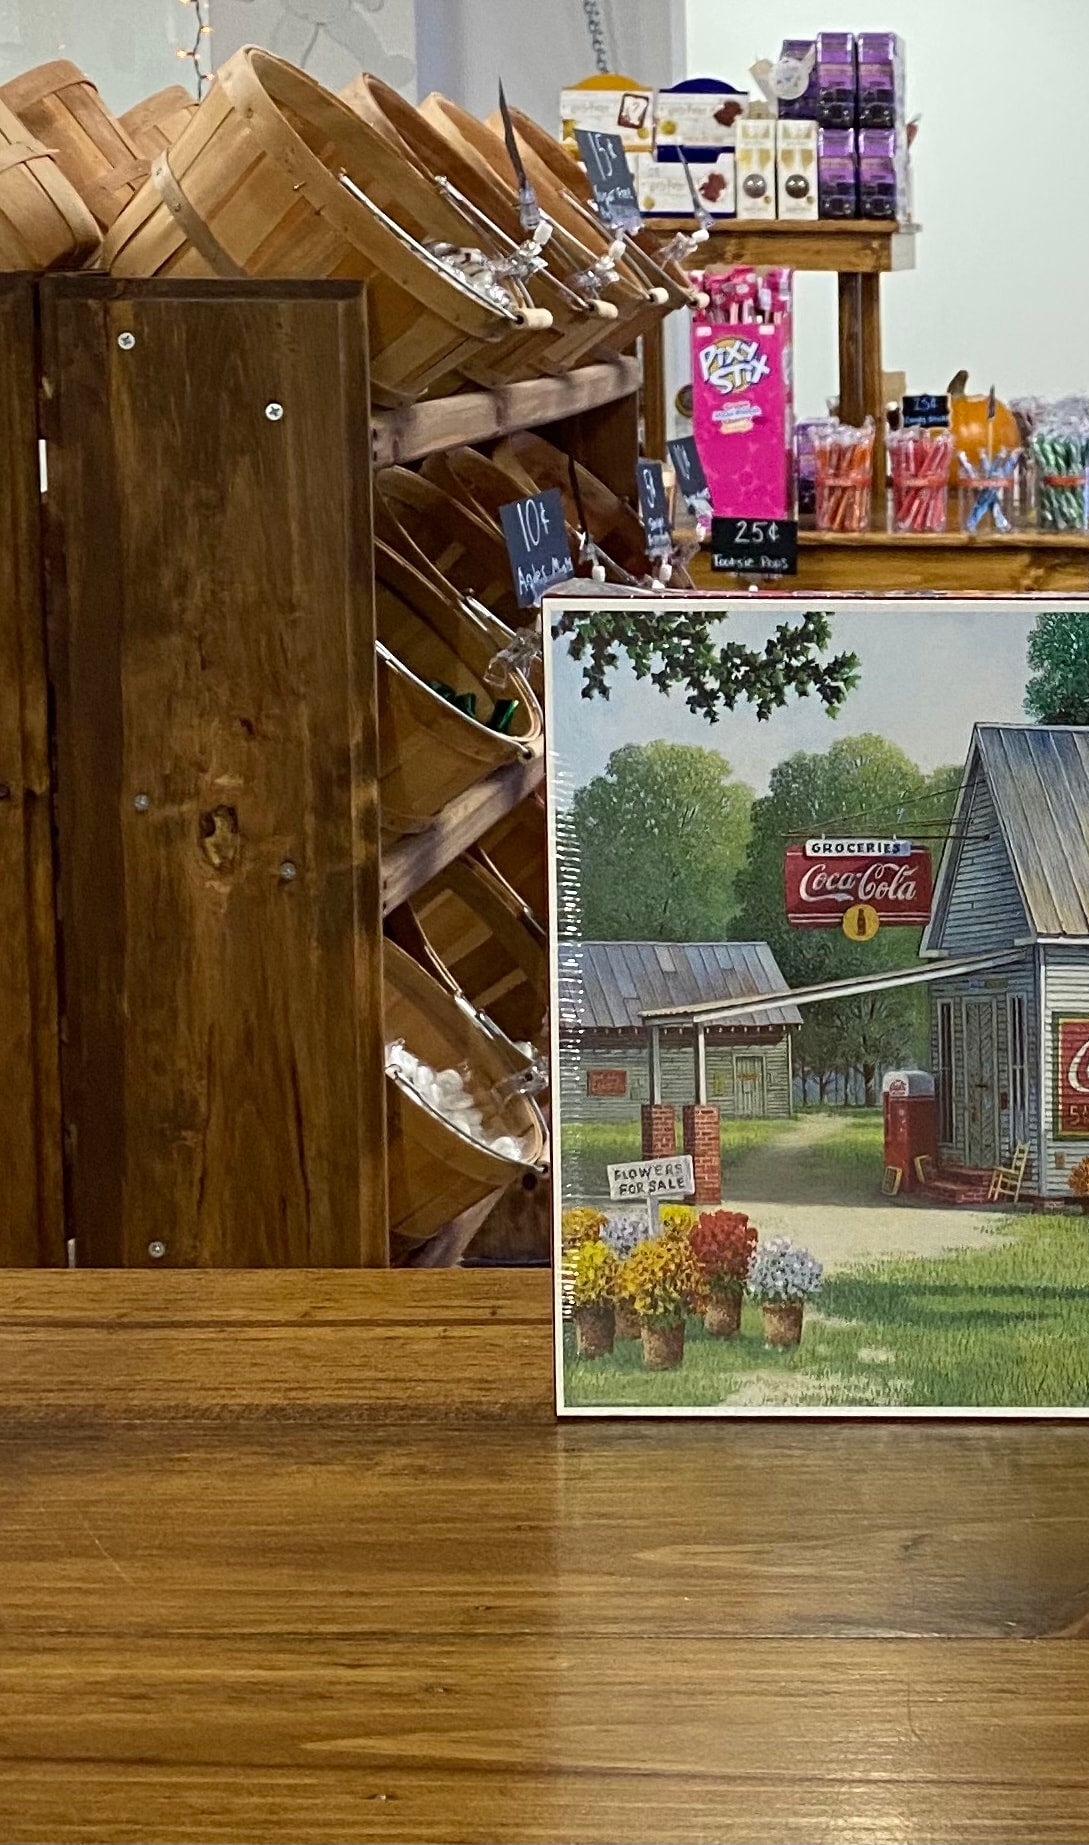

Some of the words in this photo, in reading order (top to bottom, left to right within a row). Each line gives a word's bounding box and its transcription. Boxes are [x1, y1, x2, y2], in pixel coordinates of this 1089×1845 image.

[516, 499, 550, 552] 10¢
[734, 520, 780, 543] 25¢
[811, 842, 901, 854] GROCERIES
[800, 863, 919, 902] Coca-Cola
[614, 1163, 683, 1181] FLOWERS
[619, 1182, 645, 1196] FOR
[649, 1177, 686, 1193] SALE
